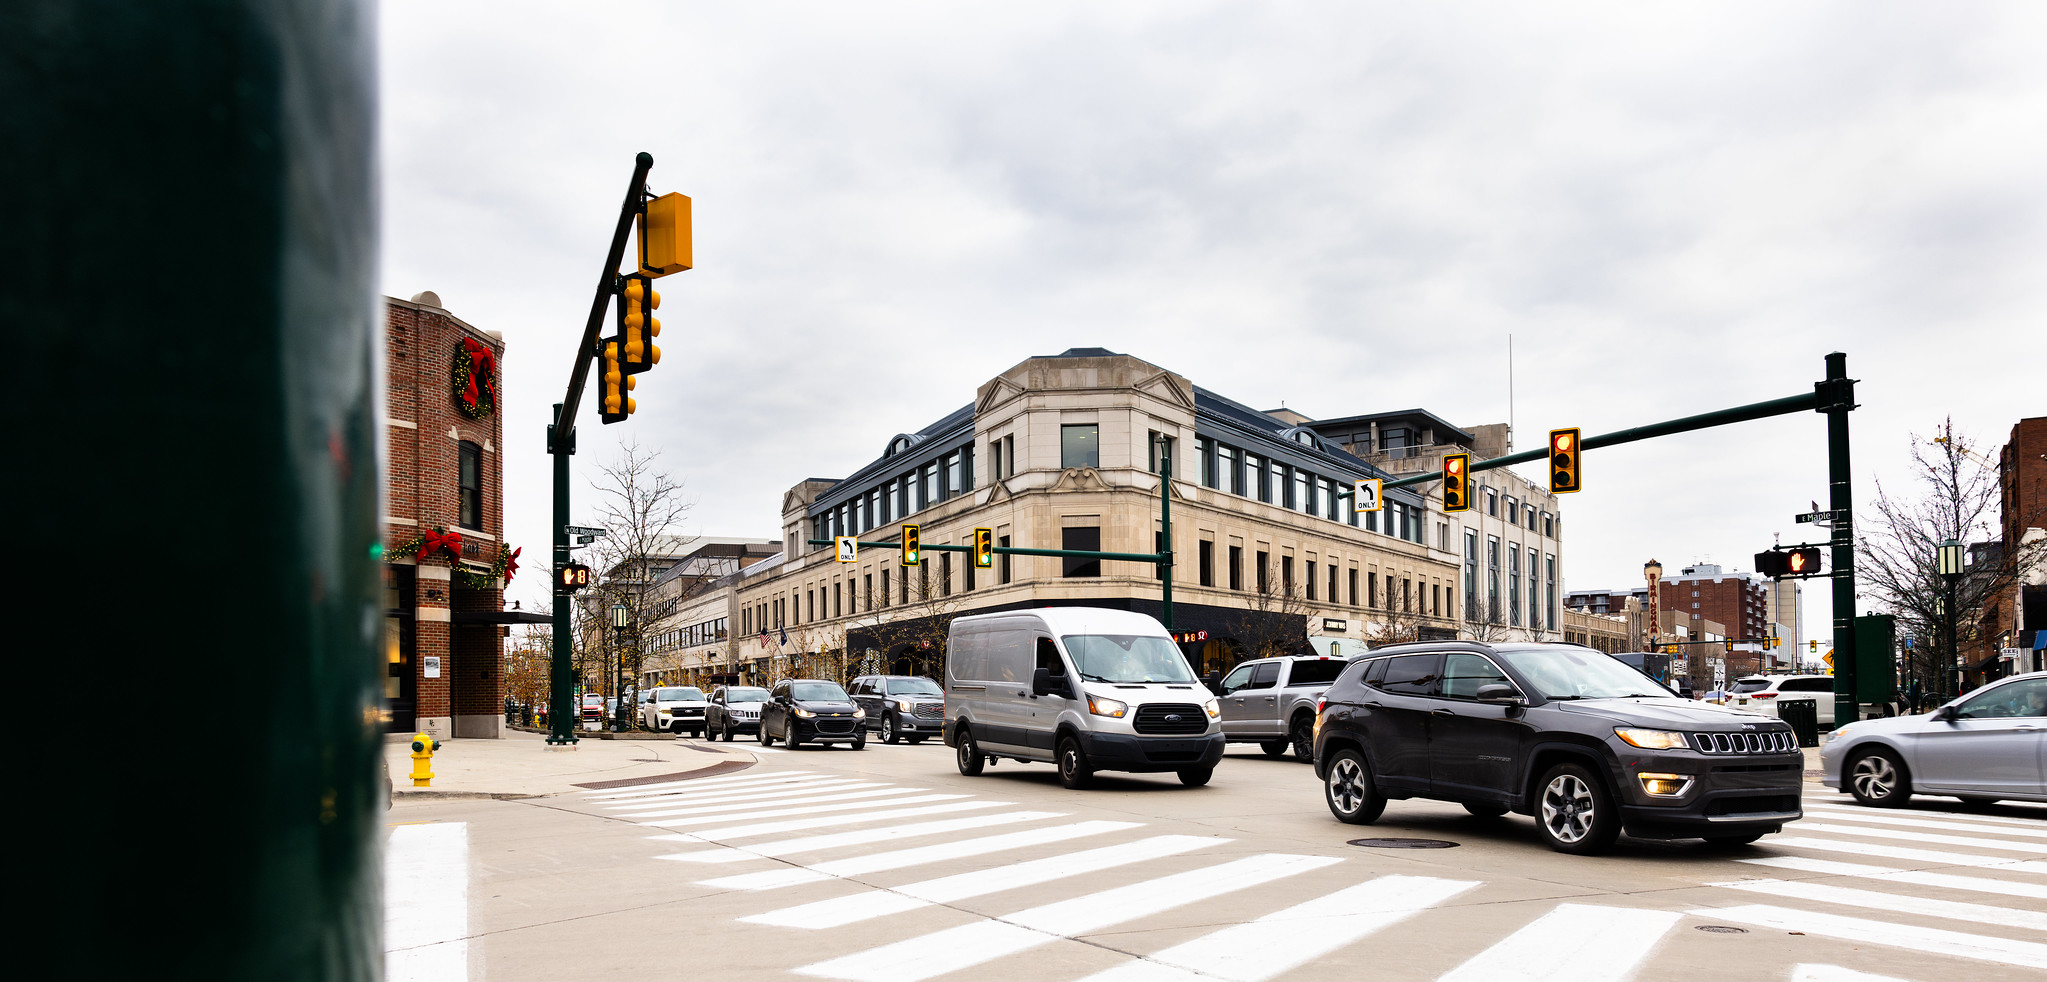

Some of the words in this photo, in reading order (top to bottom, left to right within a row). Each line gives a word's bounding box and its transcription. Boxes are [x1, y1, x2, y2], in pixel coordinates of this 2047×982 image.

[1358, 501, 1376, 509] ONLY
[1807, 512, 1831, 521] Maple
[580, 528, 605, 536] Woodward
